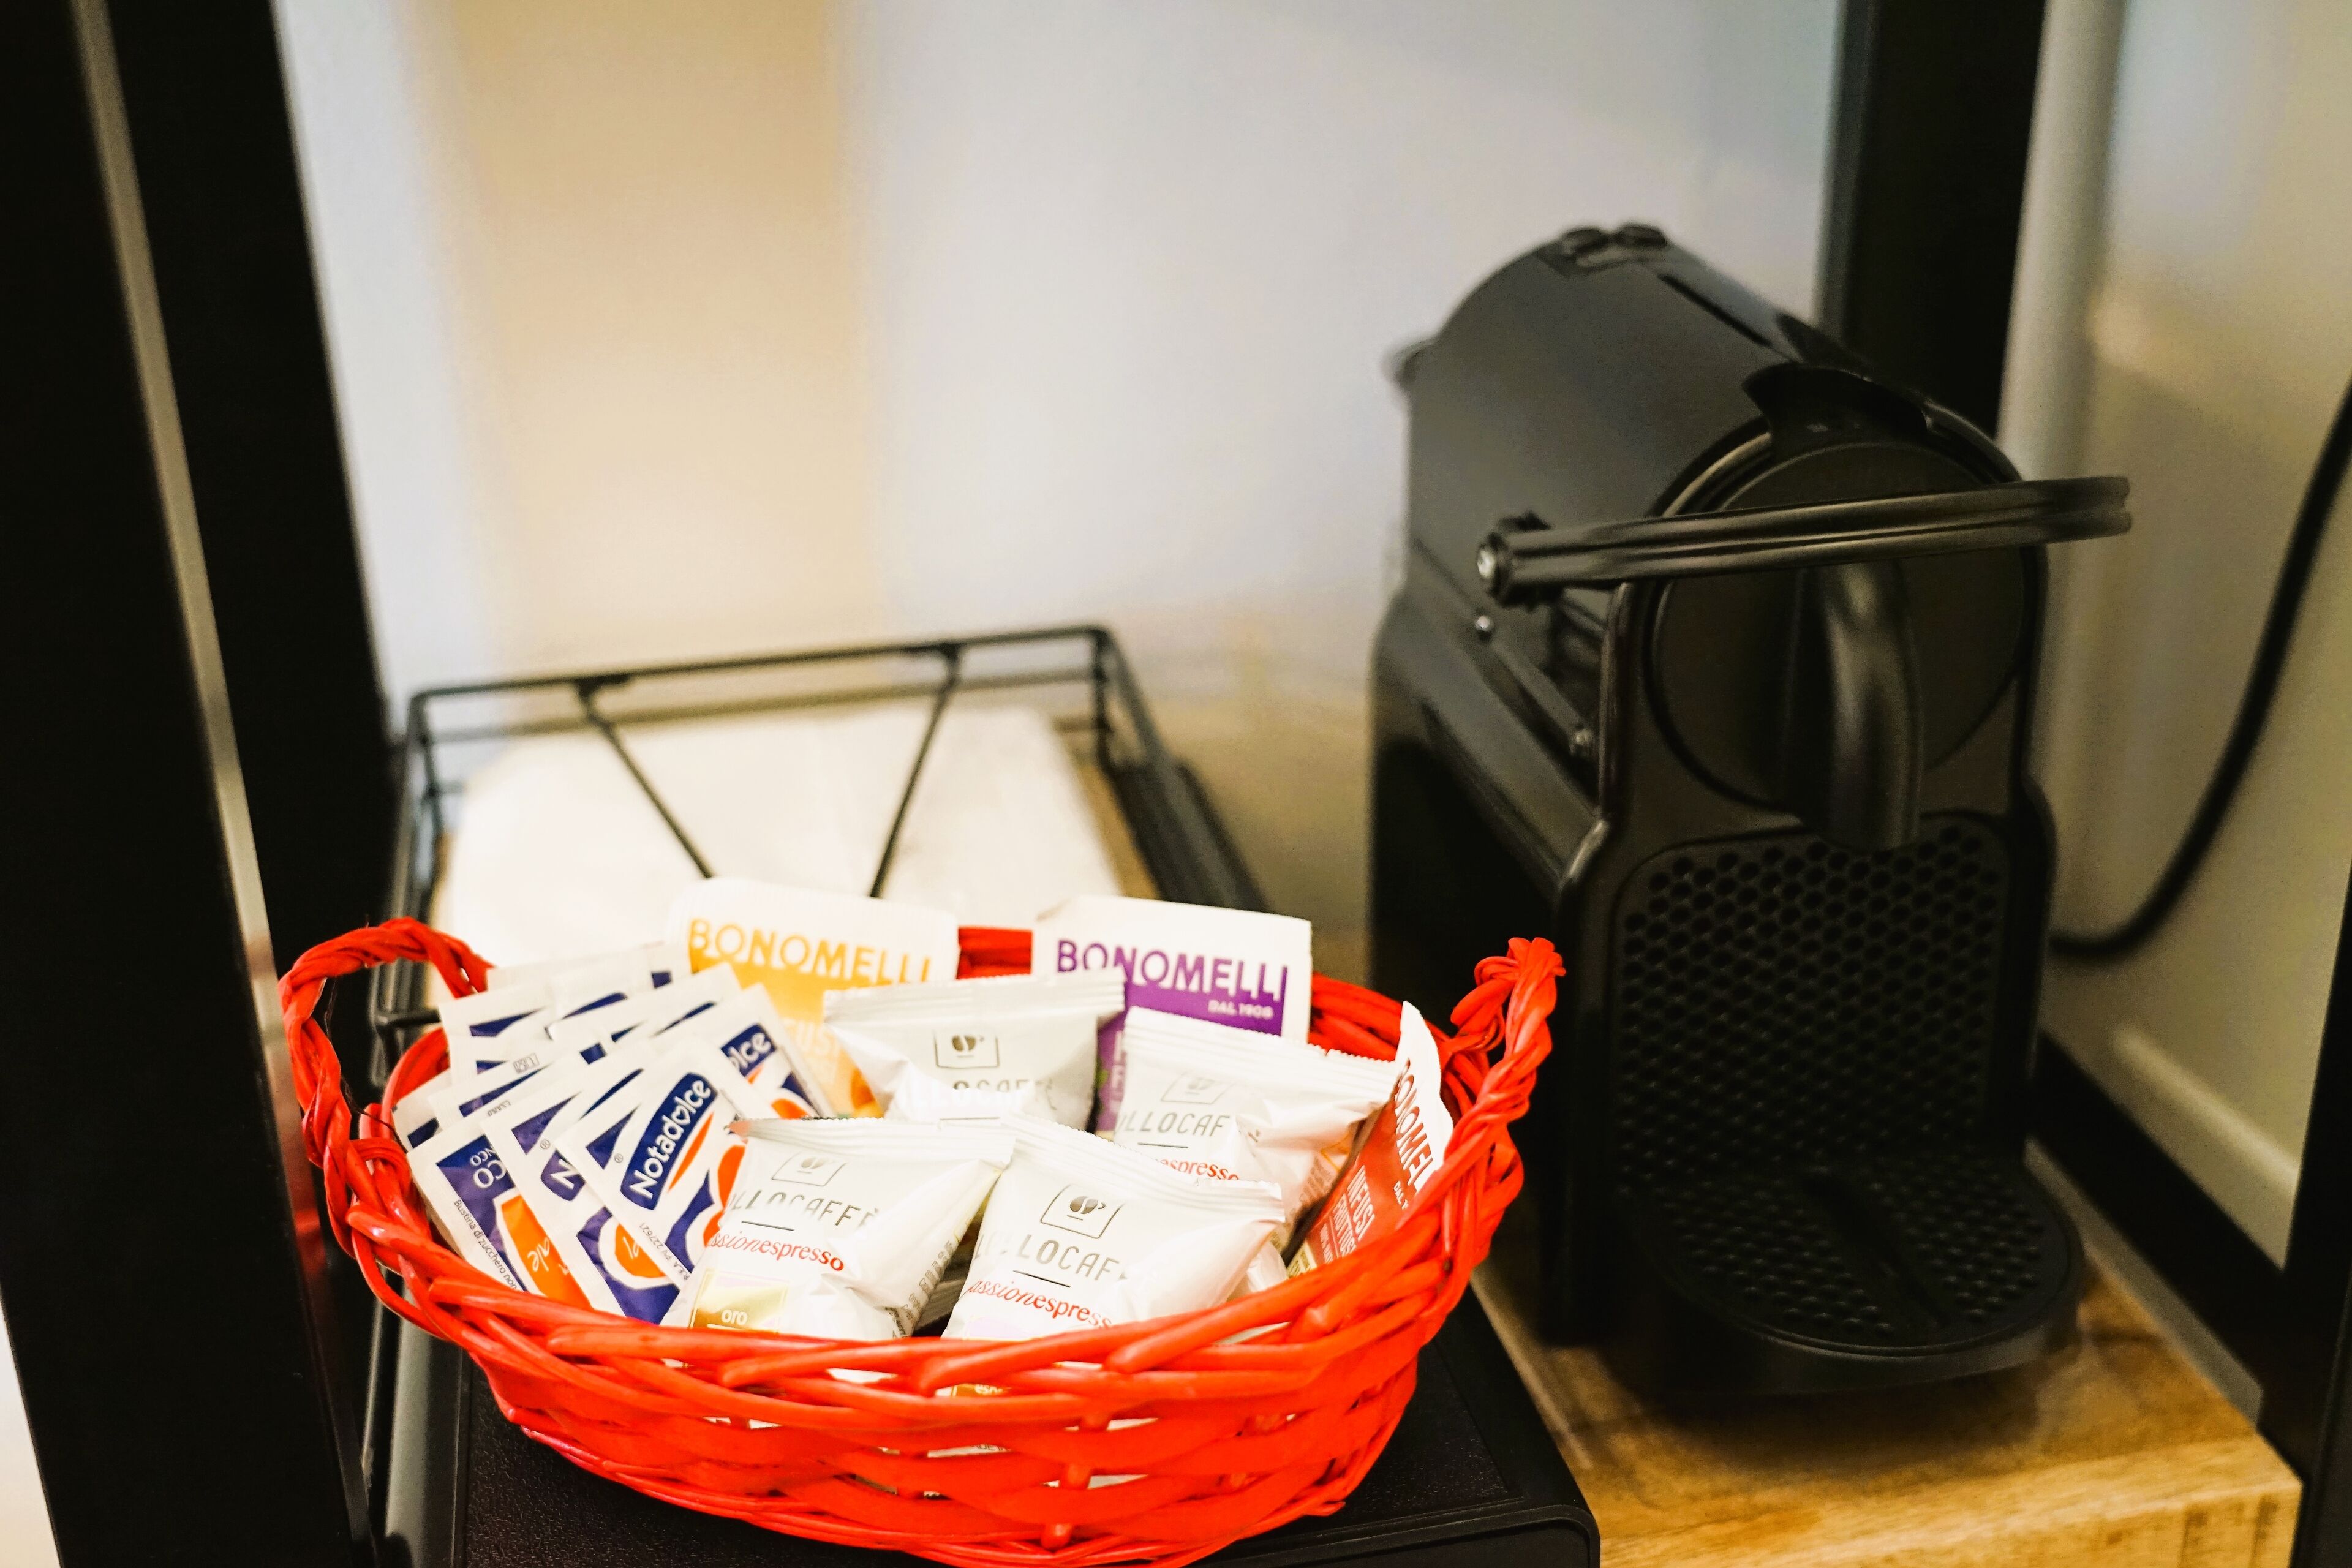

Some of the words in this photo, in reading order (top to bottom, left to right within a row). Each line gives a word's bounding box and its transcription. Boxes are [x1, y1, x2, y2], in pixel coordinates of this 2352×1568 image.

[688, 918, 930, 982] BONOMELLI
[1057, 939, 1288, 1001] BONOMELLI
[629, 1080, 710, 1199] Notadolce
[454, 1199, 476, 1230] Bustina
[473, 1227, 483, 1240] di
[478, 1239, 506, 1275] zucchero
[1348, 1164, 1375, 1242] INFUSI
[721, 1309, 748, 1325] oro
